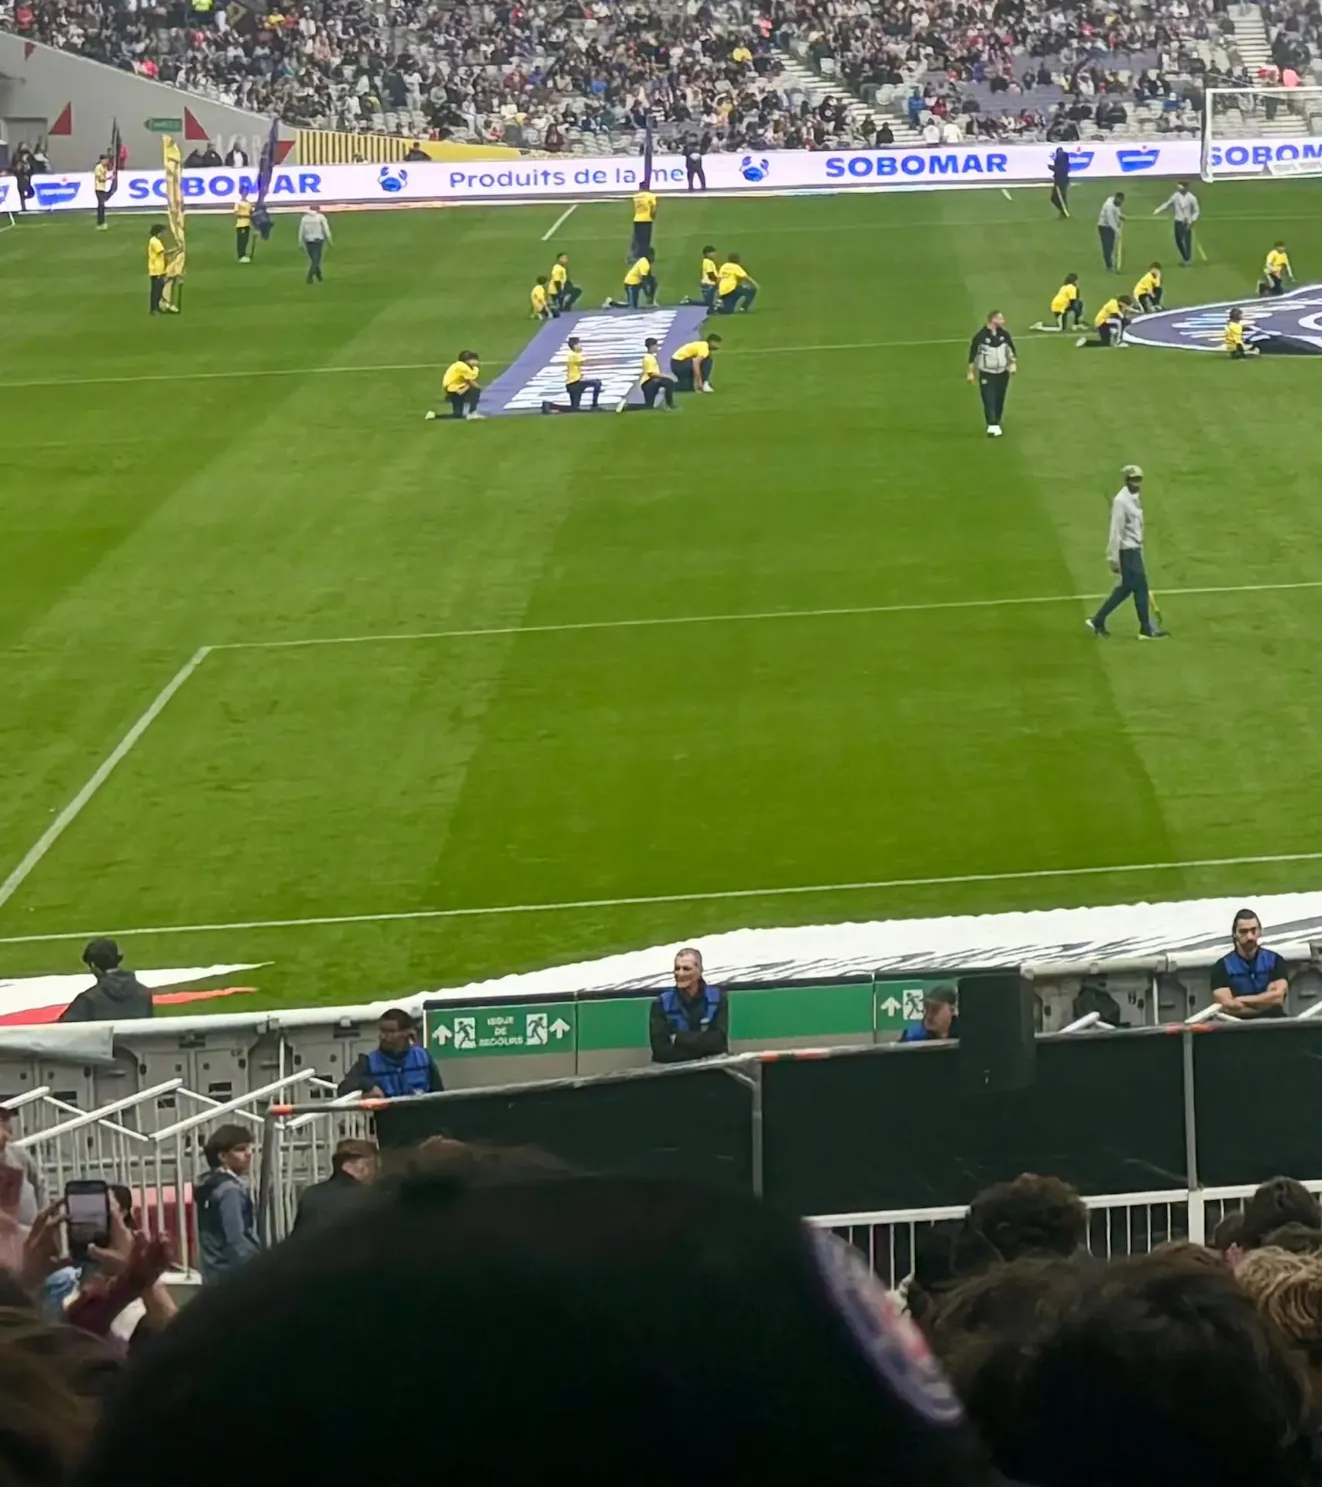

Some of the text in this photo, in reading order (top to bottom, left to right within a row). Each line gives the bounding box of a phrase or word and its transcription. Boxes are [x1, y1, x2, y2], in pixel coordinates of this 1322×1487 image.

[826, 153, 1007, 177] SOBOMAR
[450, 167, 686, 188] Produits de la me
